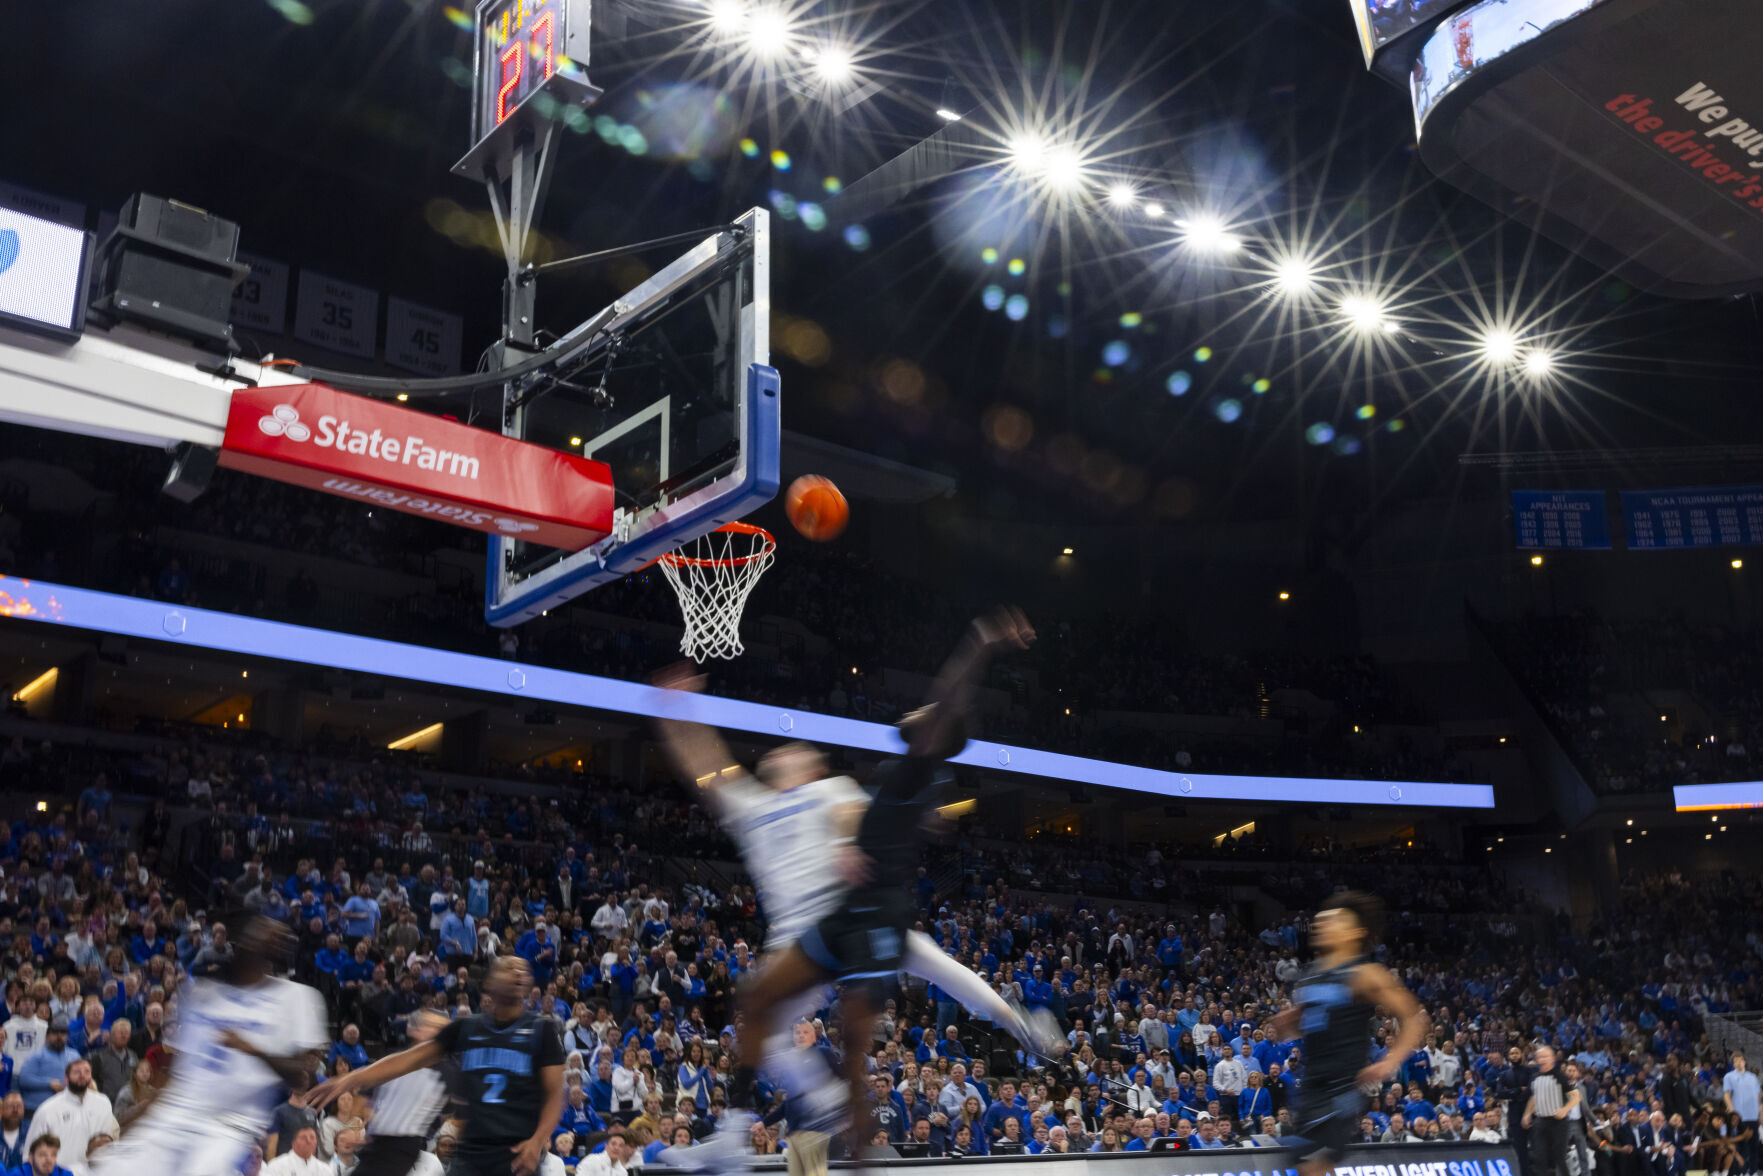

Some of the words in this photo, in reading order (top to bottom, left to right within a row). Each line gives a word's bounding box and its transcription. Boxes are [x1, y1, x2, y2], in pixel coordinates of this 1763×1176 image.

[1674, 81, 1729, 123] We
[1605, 93, 1664, 133] the
[1653, 129, 1762, 198] driver's
[322, 302, 352, 329] 35
[410, 328, 440, 354] 45
[1530, 502, 1591, 511] APPEARANCES
[1650, 496, 1675, 505] NCAA
[1677, 494, 1735, 504] TOURNAMENT
[481, 1073, 508, 1103] 2
